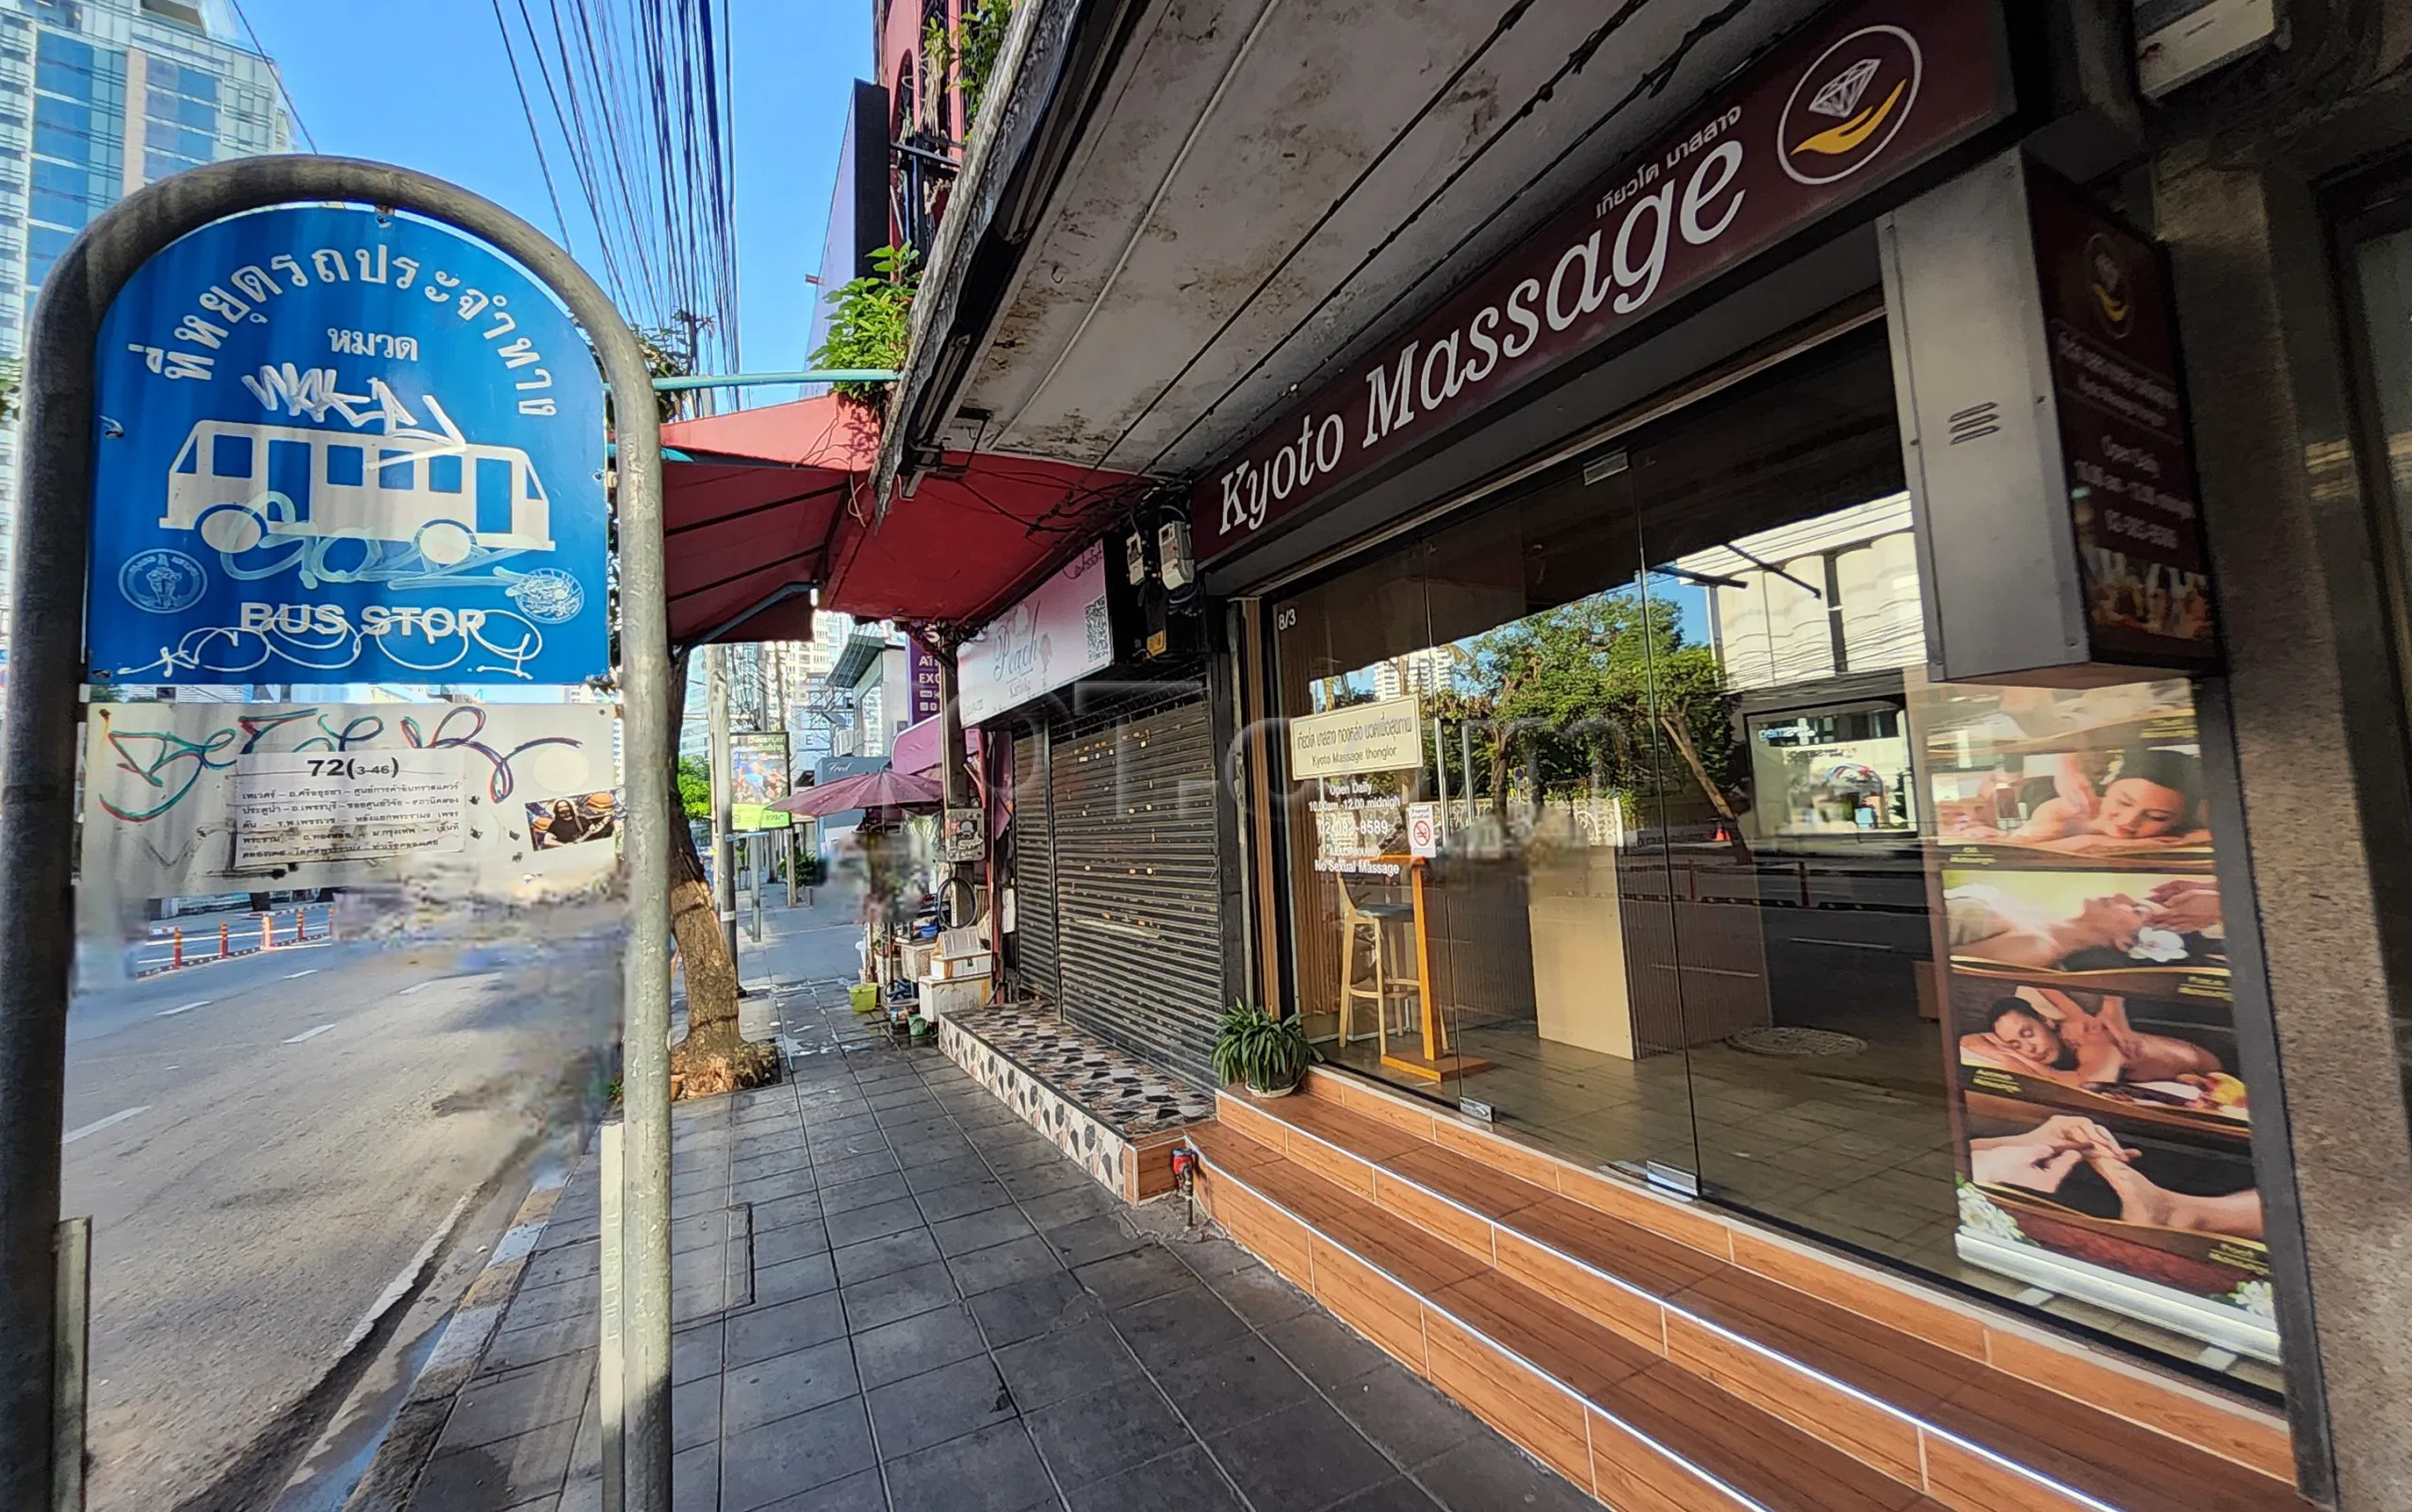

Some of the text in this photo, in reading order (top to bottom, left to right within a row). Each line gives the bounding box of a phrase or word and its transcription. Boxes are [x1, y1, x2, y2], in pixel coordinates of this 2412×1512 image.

[127, 244, 557, 417] ที่หยุดรถประจำทาง
[1219, 141, 1749, 537] Kyoto Massage
[328, 327, 418, 362] หมวด
[240, 602, 486, 639] BUS STOP
[1278, 608, 1296, 631] 8/3
[307, 756, 399, 780] 72(3-46)
[1311, 744, 1398, 770] Kyoto Massage thonglor
[1328, 782, 1373, 796] Open Daily
[1313, 859, 1400, 878] No Sexual Massage
